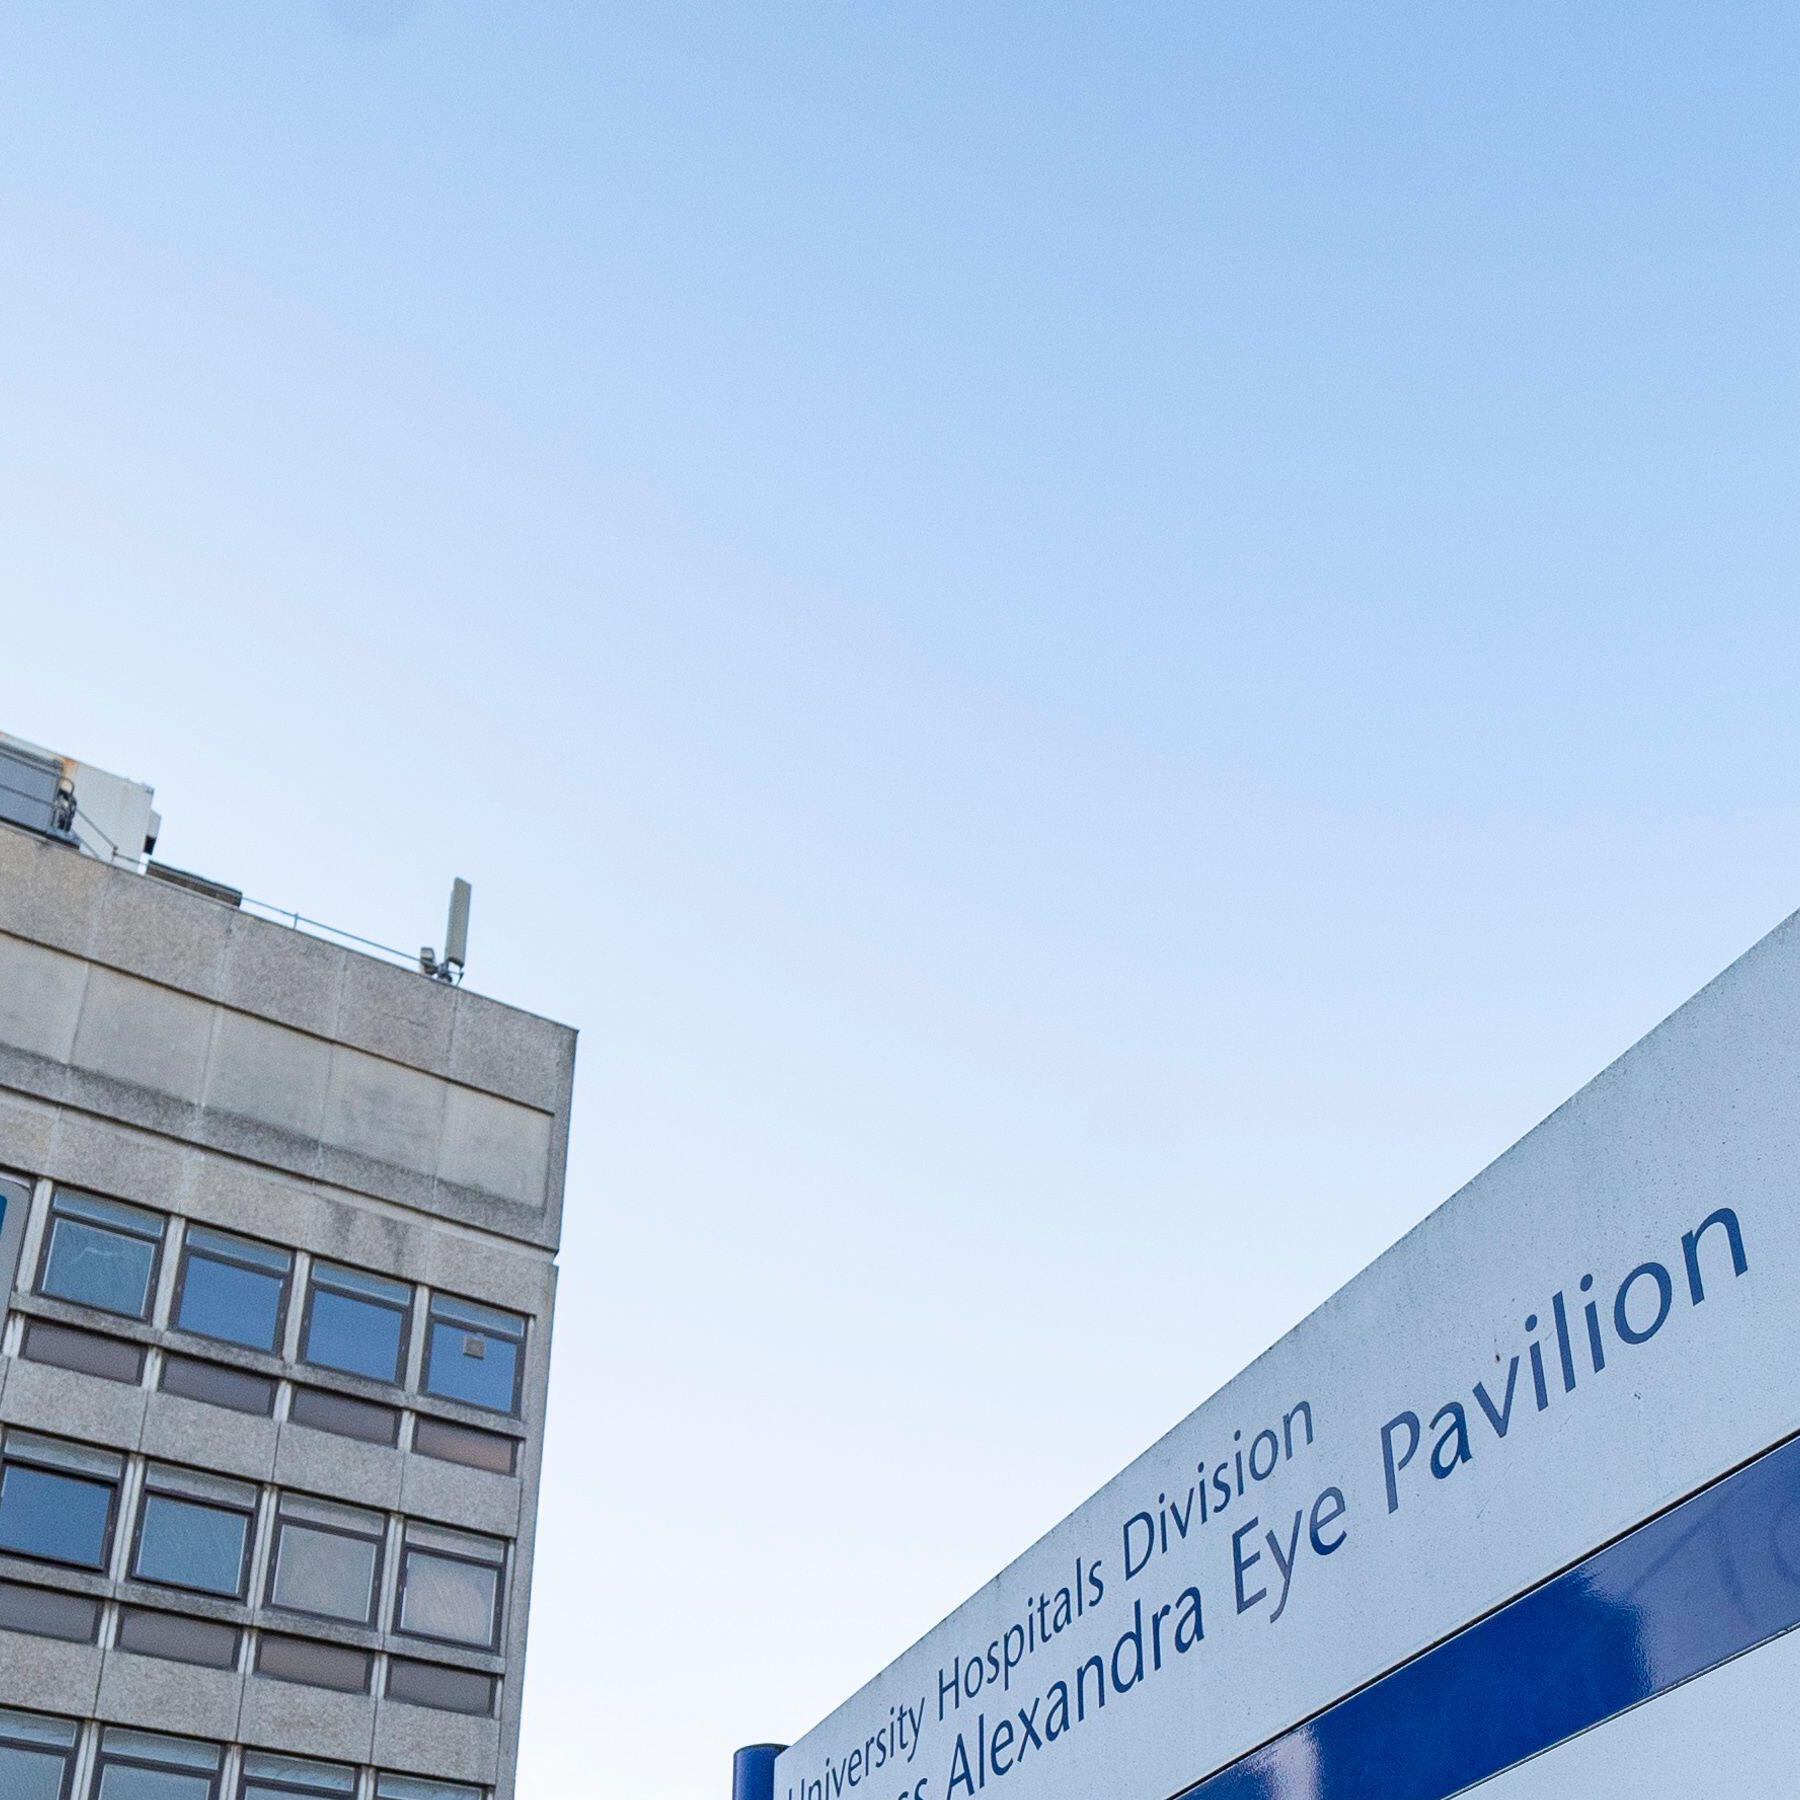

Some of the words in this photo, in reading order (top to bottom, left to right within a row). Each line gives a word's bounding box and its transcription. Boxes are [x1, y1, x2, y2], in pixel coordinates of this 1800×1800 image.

[936, 1553, 1105, 1724] Hospitals
[1122, 1398, 1315, 1582] Division
[1229, 1485, 1347, 1624] Eye
[1379, 1206, 1750, 1514] Pavilion
